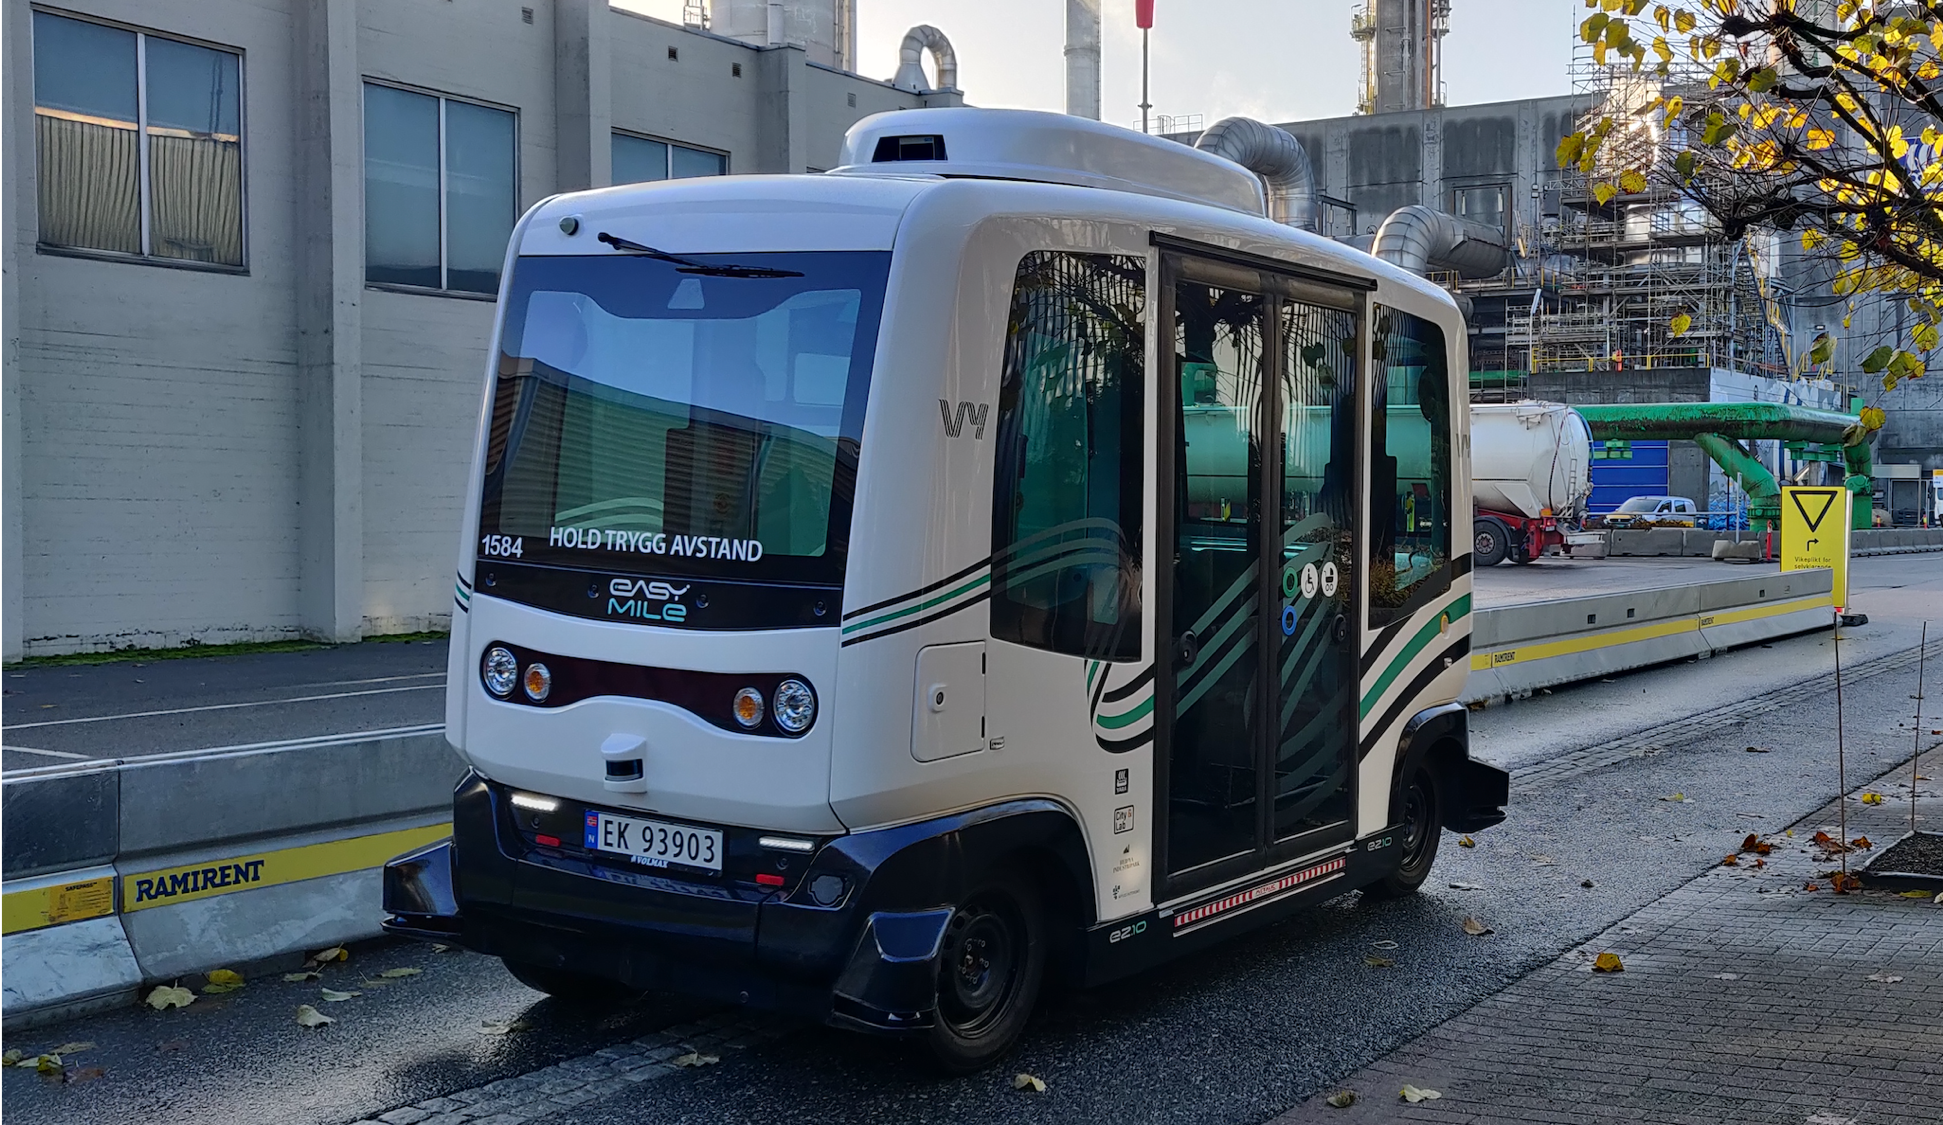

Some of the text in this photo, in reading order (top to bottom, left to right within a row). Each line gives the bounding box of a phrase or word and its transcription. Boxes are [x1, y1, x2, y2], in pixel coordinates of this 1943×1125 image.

[481, 533, 523, 559] 1584
[550, 526, 763, 562] HOLD TRYGG AVSTAND
[1494, 651, 1516, 664] RAMIRENT
[1116, 811, 1127, 821] City
[1116, 820, 1126, 831] Lab
[588, 834, 595, 844] N
[604, 819, 715, 863] EK 93903
[135, 859, 265, 903] RAMIRENT
